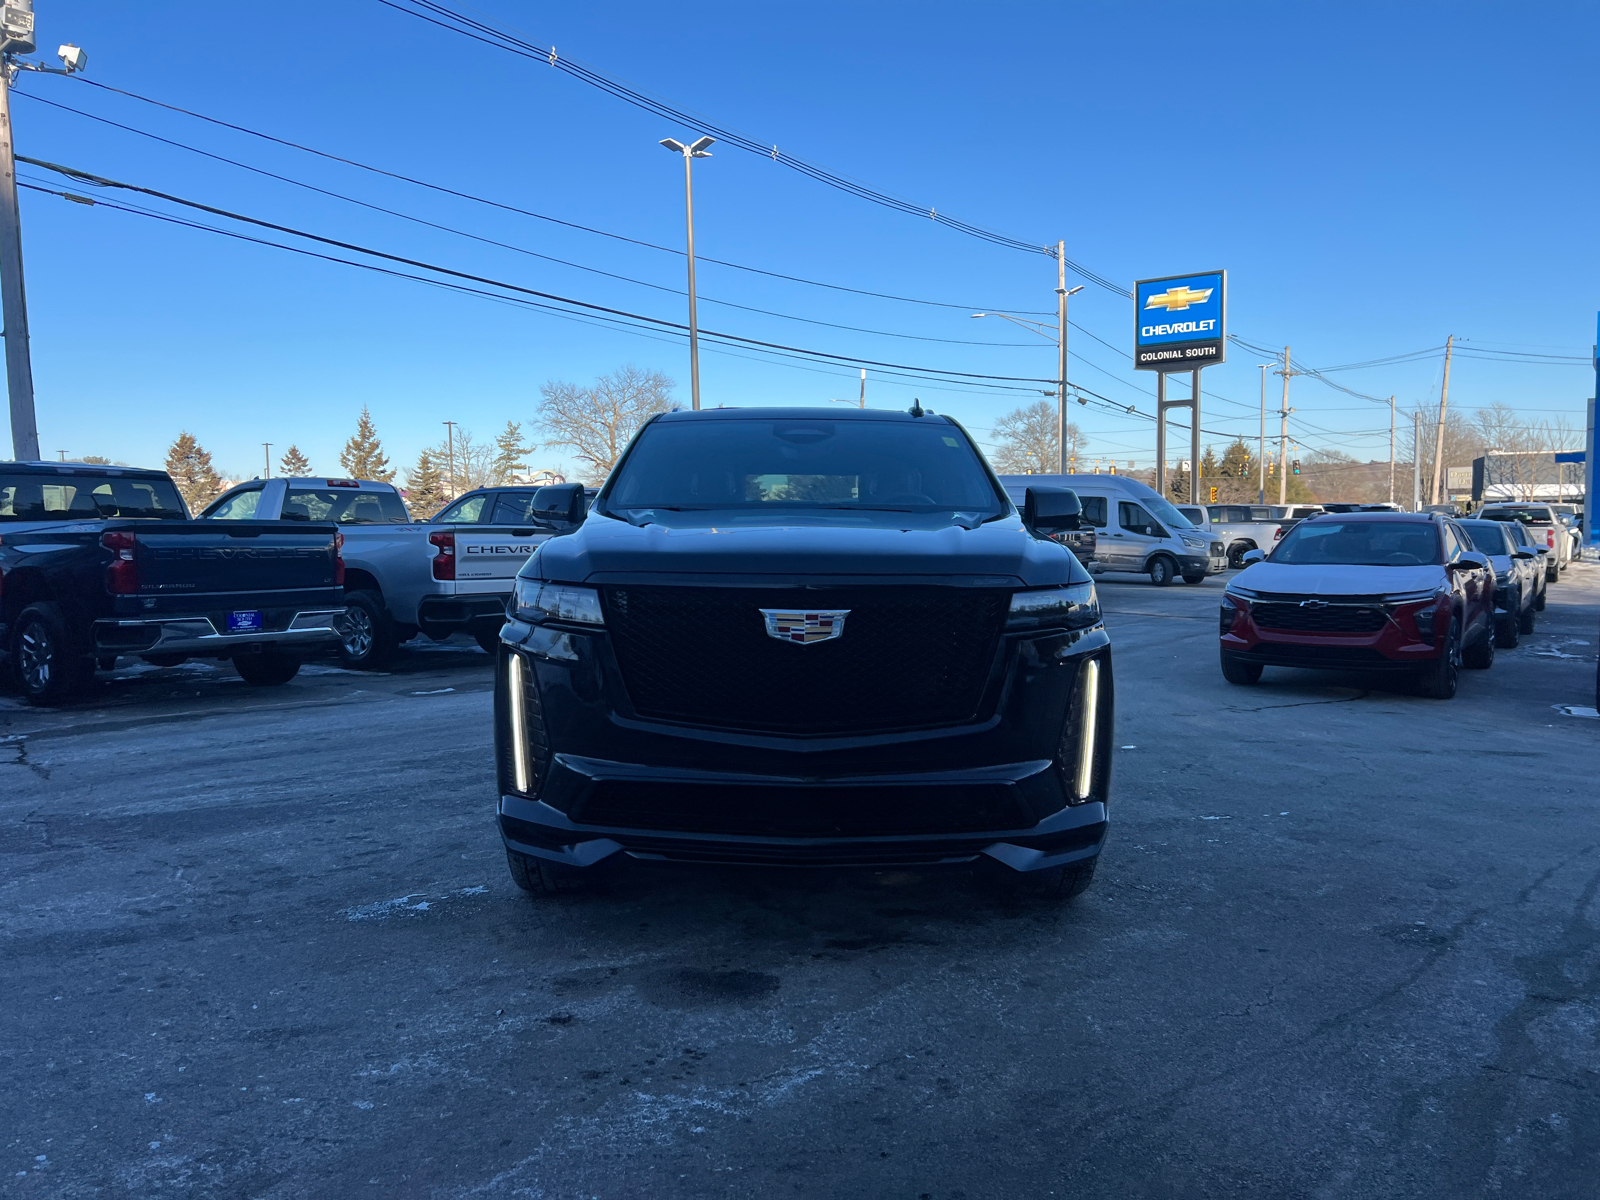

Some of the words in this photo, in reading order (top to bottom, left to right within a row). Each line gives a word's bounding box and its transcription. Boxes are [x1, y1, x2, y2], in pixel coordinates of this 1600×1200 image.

[1142, 319, 1216, 336] CHEVROLET
[1141, 350, 1183, 361] COLONIAL
[1186, 346, 1216, 357] SOUTH
[154, 548, 326, 559] CHEVROLET
